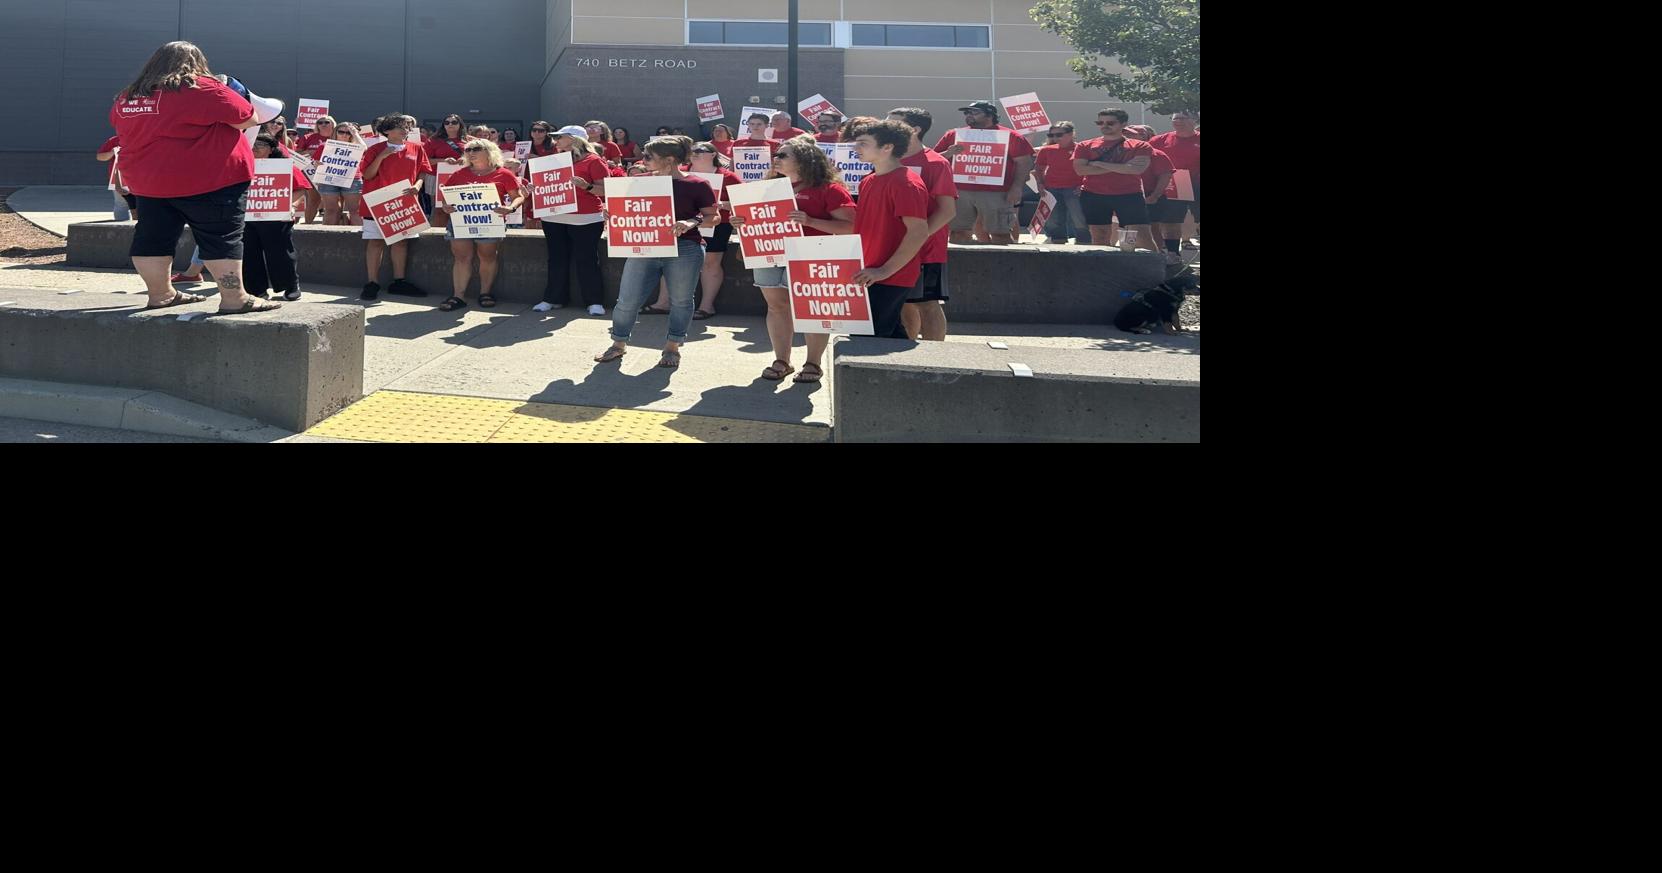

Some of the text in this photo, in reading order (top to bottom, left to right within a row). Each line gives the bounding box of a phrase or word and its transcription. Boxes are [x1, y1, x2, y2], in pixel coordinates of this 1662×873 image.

[576, 58, 697, 69] 740 BETZ ROAD
[1015, 105, 1031, 113] Fair
[1011, 110, 1044, 121] Contract
[1021, 118, 1041, 128] Now!
[334, 147, 352, 157] Fair
[969, 144, 992, 153] FAIR
[743, 153, 760, 161] Fair
[848, 150, 861, 159] Fa
[955, 154, 1004, 165] CONTRACT
[321, 155, 358, 168] Contract
[735, 162, 770, 170] Contract
[837, 161, 875, 171] Contrac
[325, 166, 348, 177] Now!
[964, 164, 991, 174] NOW!
[543, 170, 561, 183] Fair
[742, 171, 763, 180] Now!
[247, 186, 290, 198] ntract
[534, 179, 573, 196] Contract
[459, 191, 483, 201] Fair
[543, 192, 567, 206] Now!
[246, 199, 278, 210] Now!
[383, 199, 404, 212] Fair
[624, 198, 653, 213] Fair
[378, 203, 420, 226] Contract
[749, 204, 777, 220] Fair
[390, 215, 417, 232] Now!
[463, 214, 492, 224] Now!
[610, 213, 672, 228] Contract
[740, 219, 800, 238] Contract
[622, 229, 660, 244] Now!
[753, 237, 785, 253] Now
[808, 262, 840, 279] Fair
[792, 280, 864, 298] Contract
[808, 299, 851, 316] Now!
